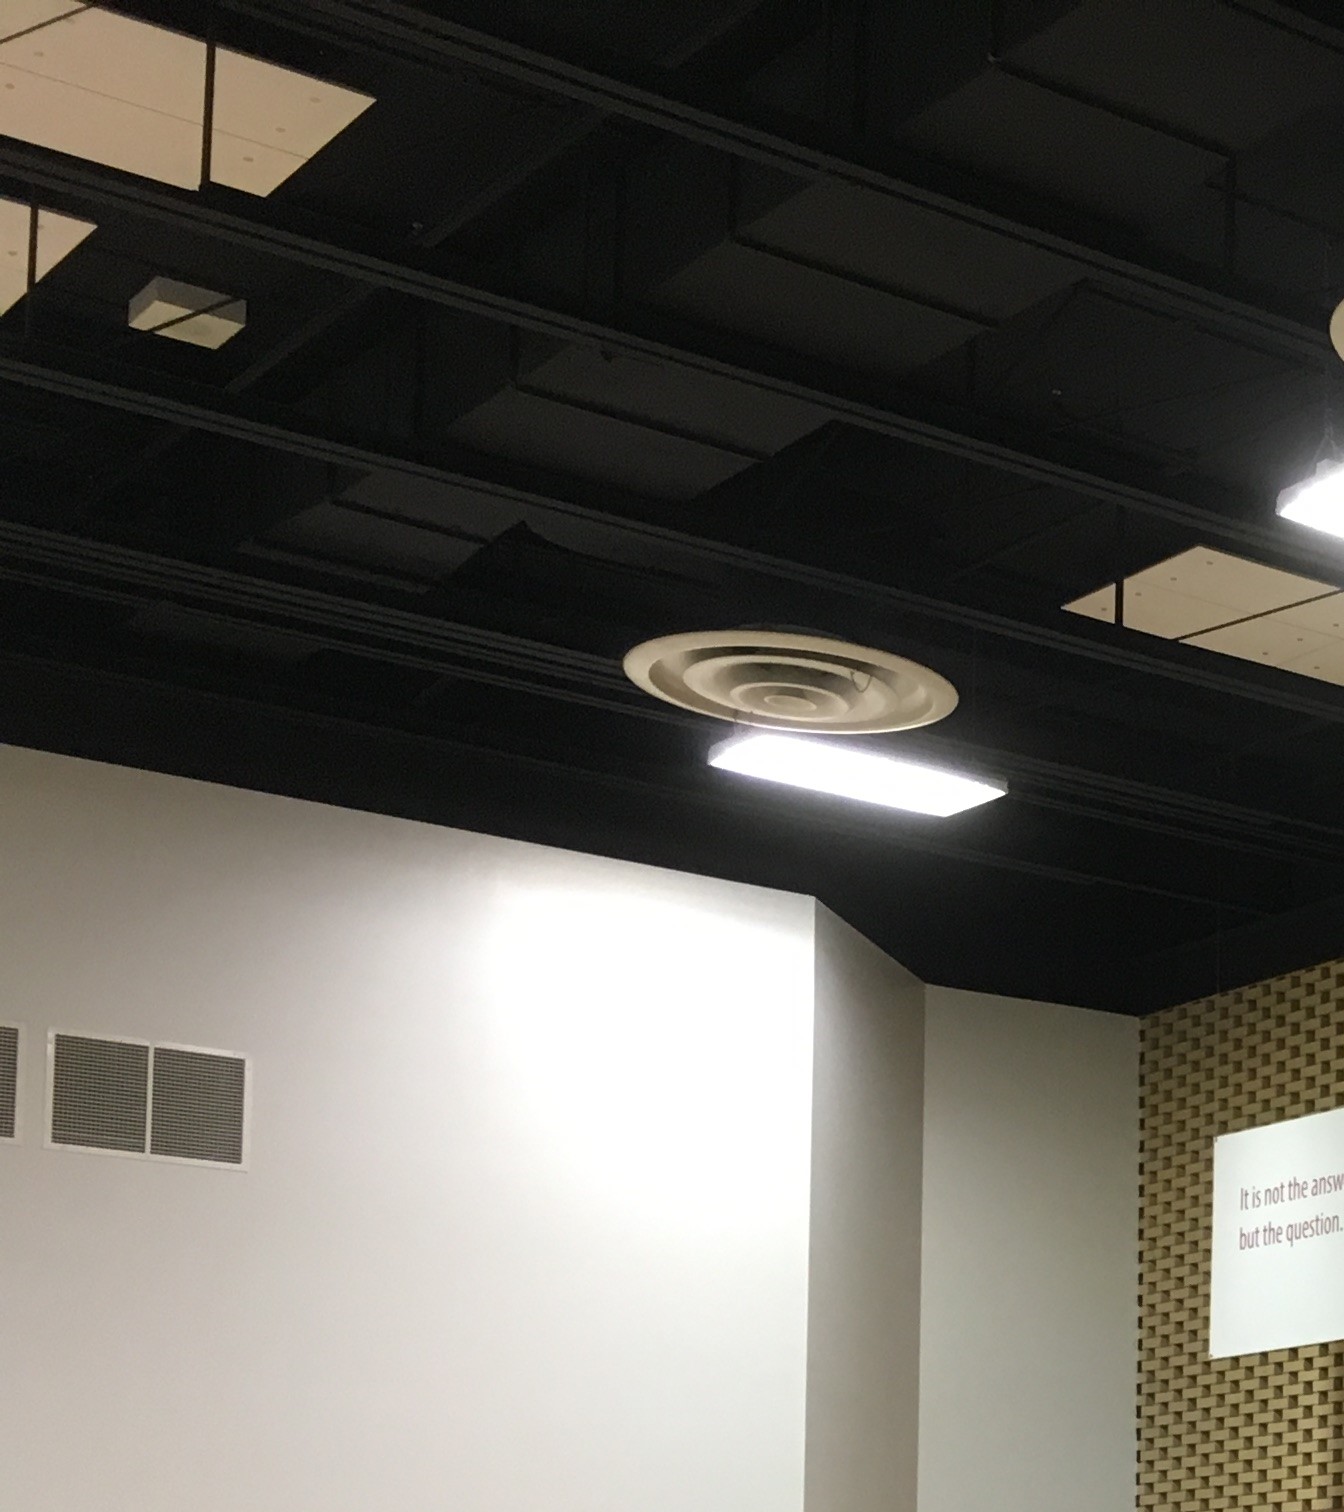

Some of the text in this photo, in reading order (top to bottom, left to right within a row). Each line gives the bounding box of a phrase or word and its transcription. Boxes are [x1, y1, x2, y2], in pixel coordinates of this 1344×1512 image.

[1239, 1187, 1249, 1211] It
[1251, 1186, 1262, 1209] is
[1264, 1182, 1285, 1206] not
[1288, 1176, 1308, 1201] the
[1239, 1212, 1344, 1250] but the question.
